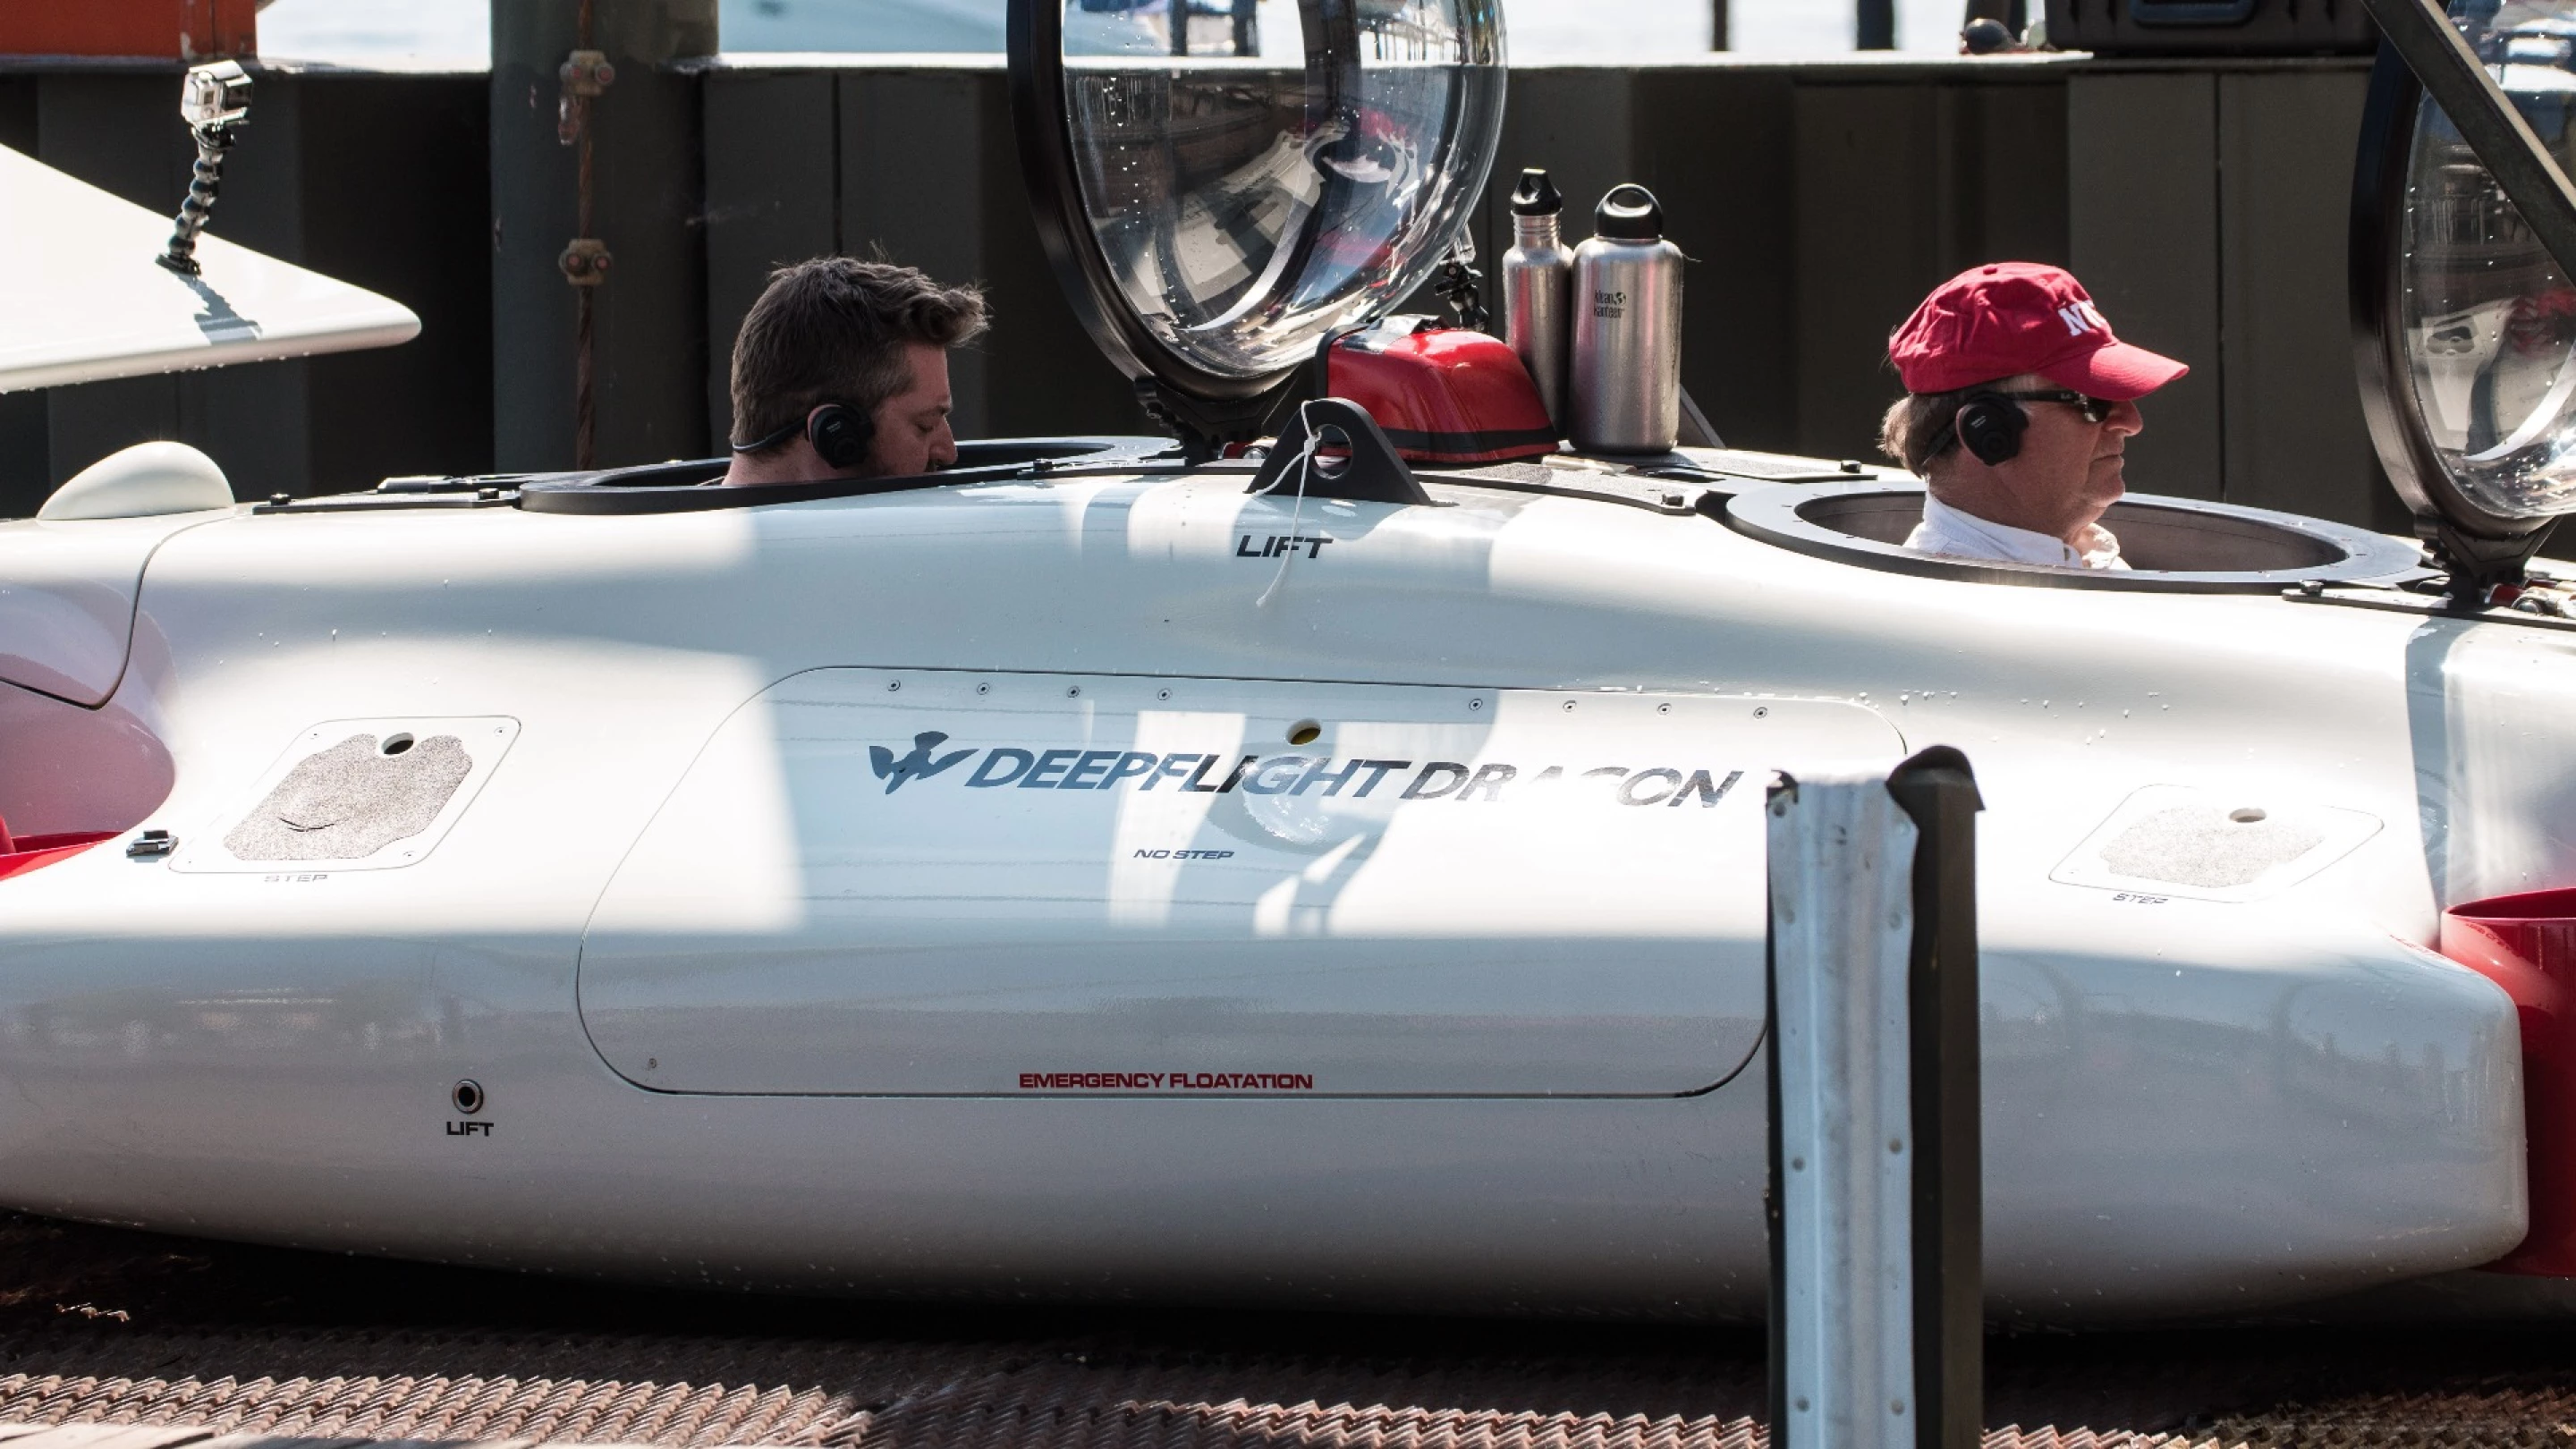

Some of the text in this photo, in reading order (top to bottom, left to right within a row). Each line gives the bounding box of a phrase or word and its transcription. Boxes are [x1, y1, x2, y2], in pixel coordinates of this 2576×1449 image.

[1236, 535, 1334, 559] LIFT
[964, 748, 1745, 809] DEEPFLIGHT DRON
[1133, 849, 1235, 860] NO STEP
[1019, 1072, 1313, 1089] EMERGENCY FLOATATION
[446, 1121, 495, 1137] LIFT
